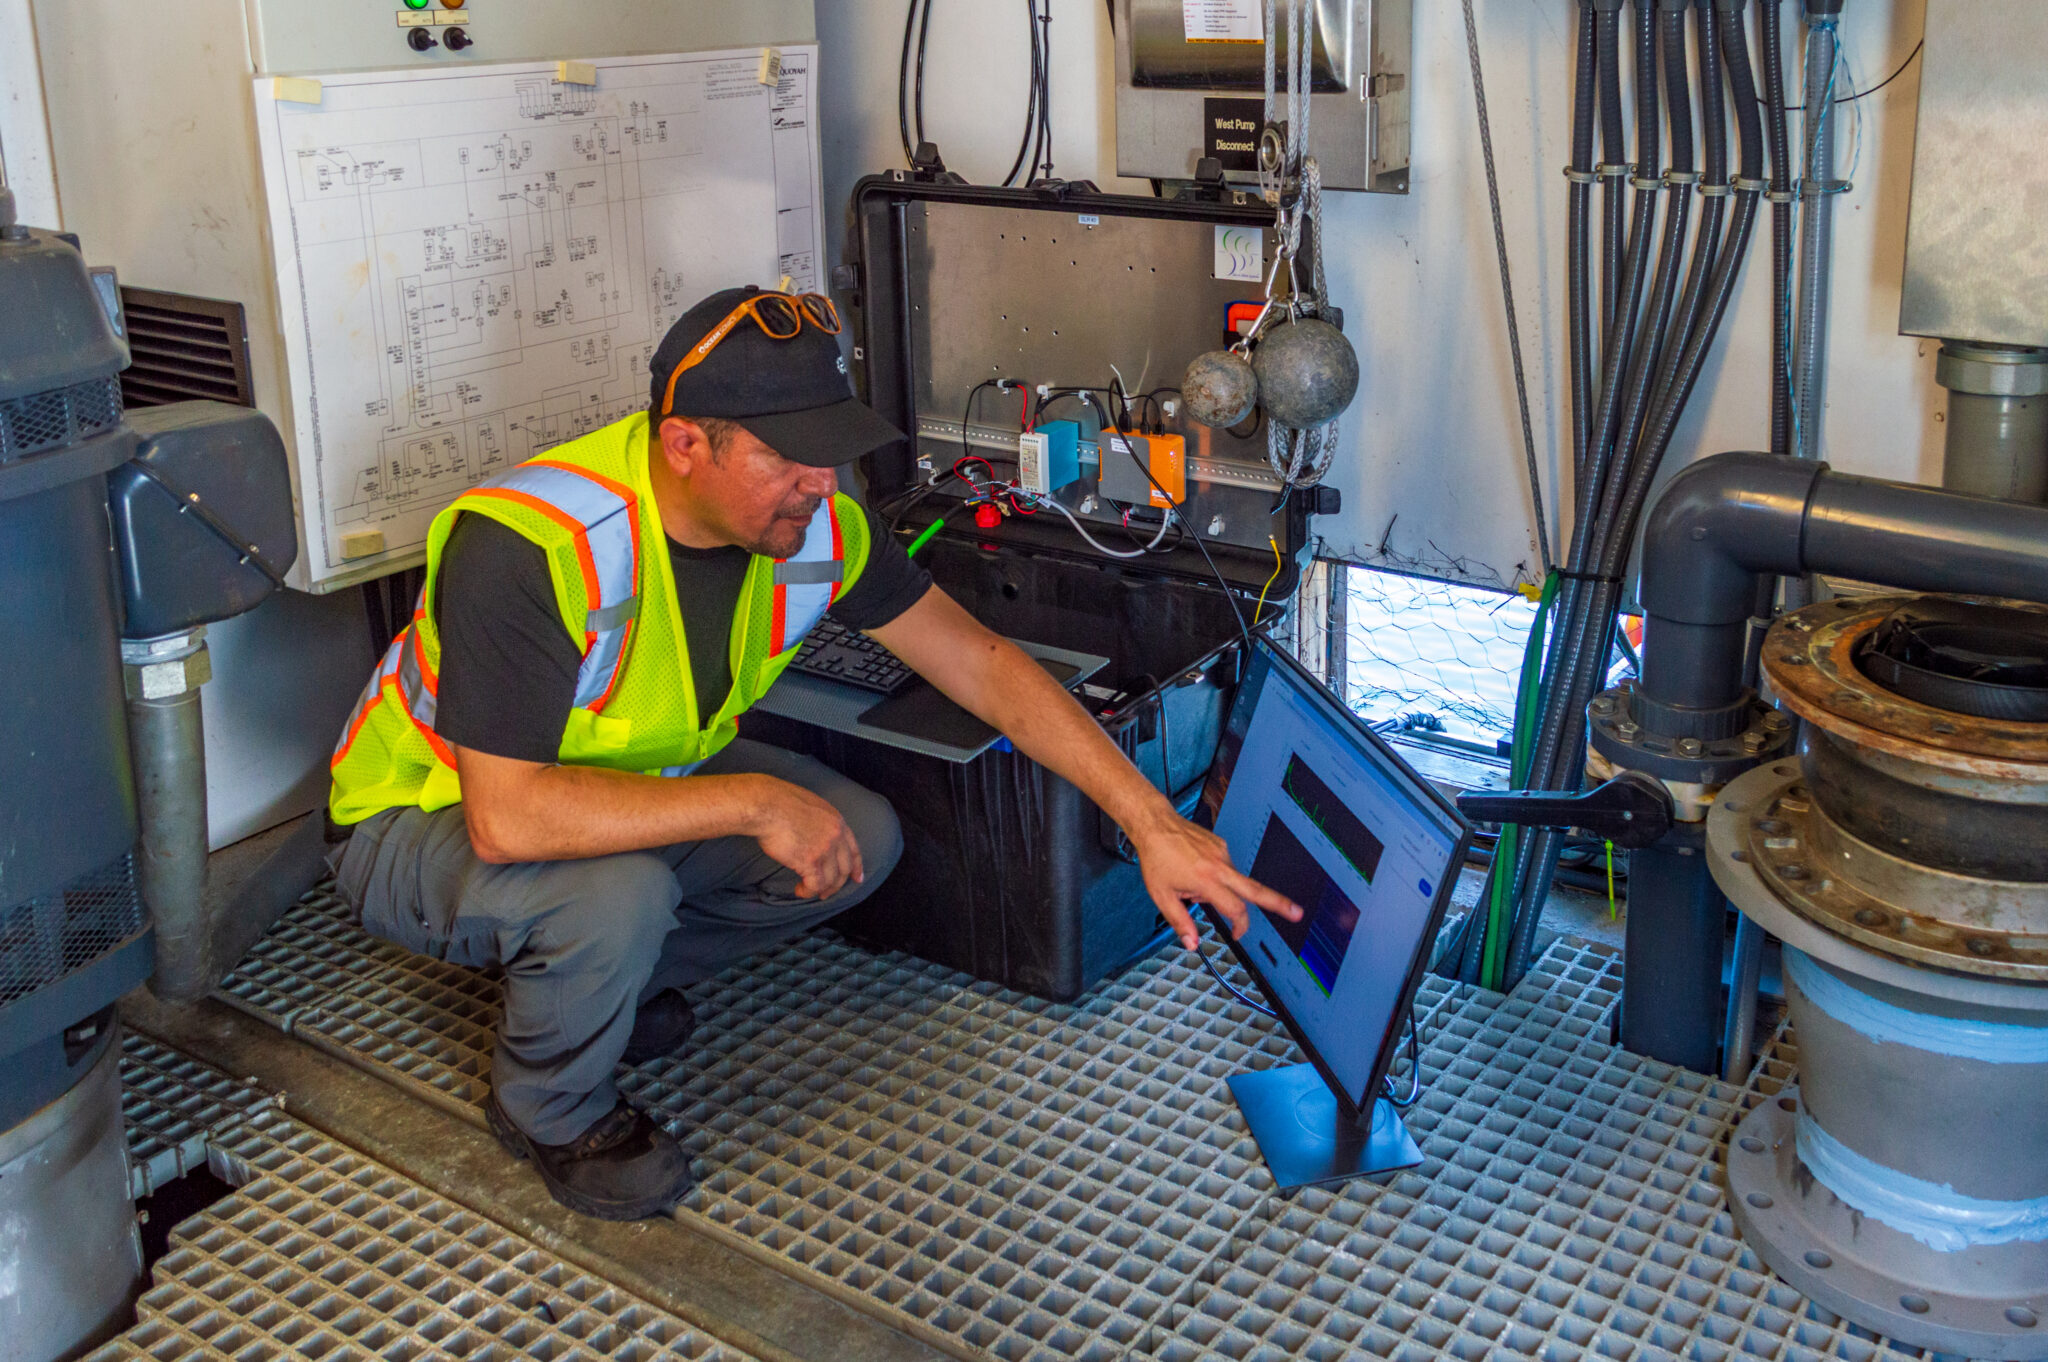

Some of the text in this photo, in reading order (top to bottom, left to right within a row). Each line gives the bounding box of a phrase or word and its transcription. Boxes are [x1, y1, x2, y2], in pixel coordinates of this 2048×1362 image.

[1215, 118, 1256, 132] West Pump
[1215, 139, 1255, 151] Disconnect
